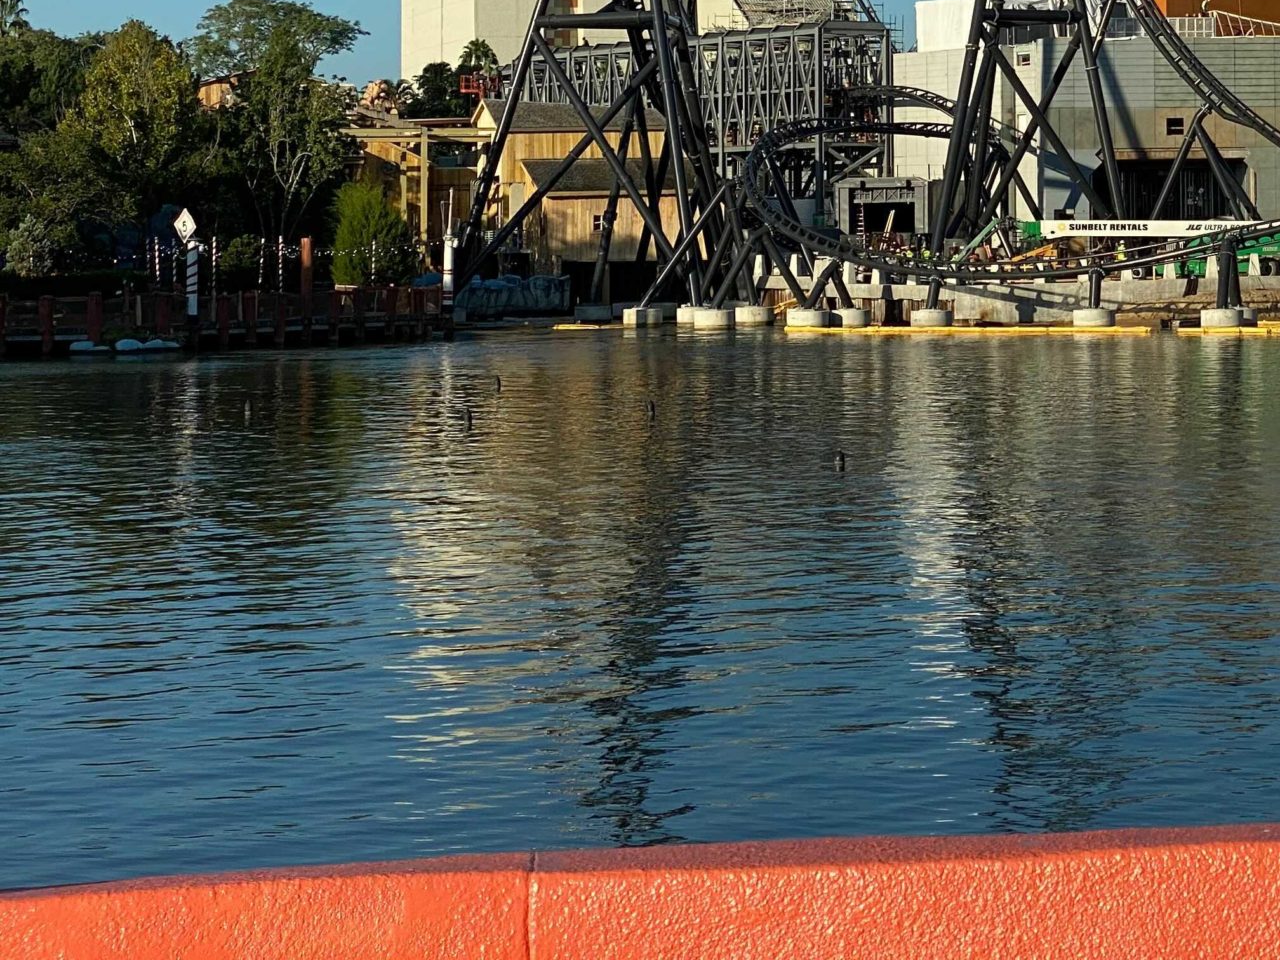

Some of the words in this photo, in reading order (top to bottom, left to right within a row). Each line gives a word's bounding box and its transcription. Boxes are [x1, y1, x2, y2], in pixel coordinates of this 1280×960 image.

[182, 220, 188, 233] 5
[1069, 223, 1108, 231] SUNBELT
[1109, 223, 1149, 231] RENTALS
